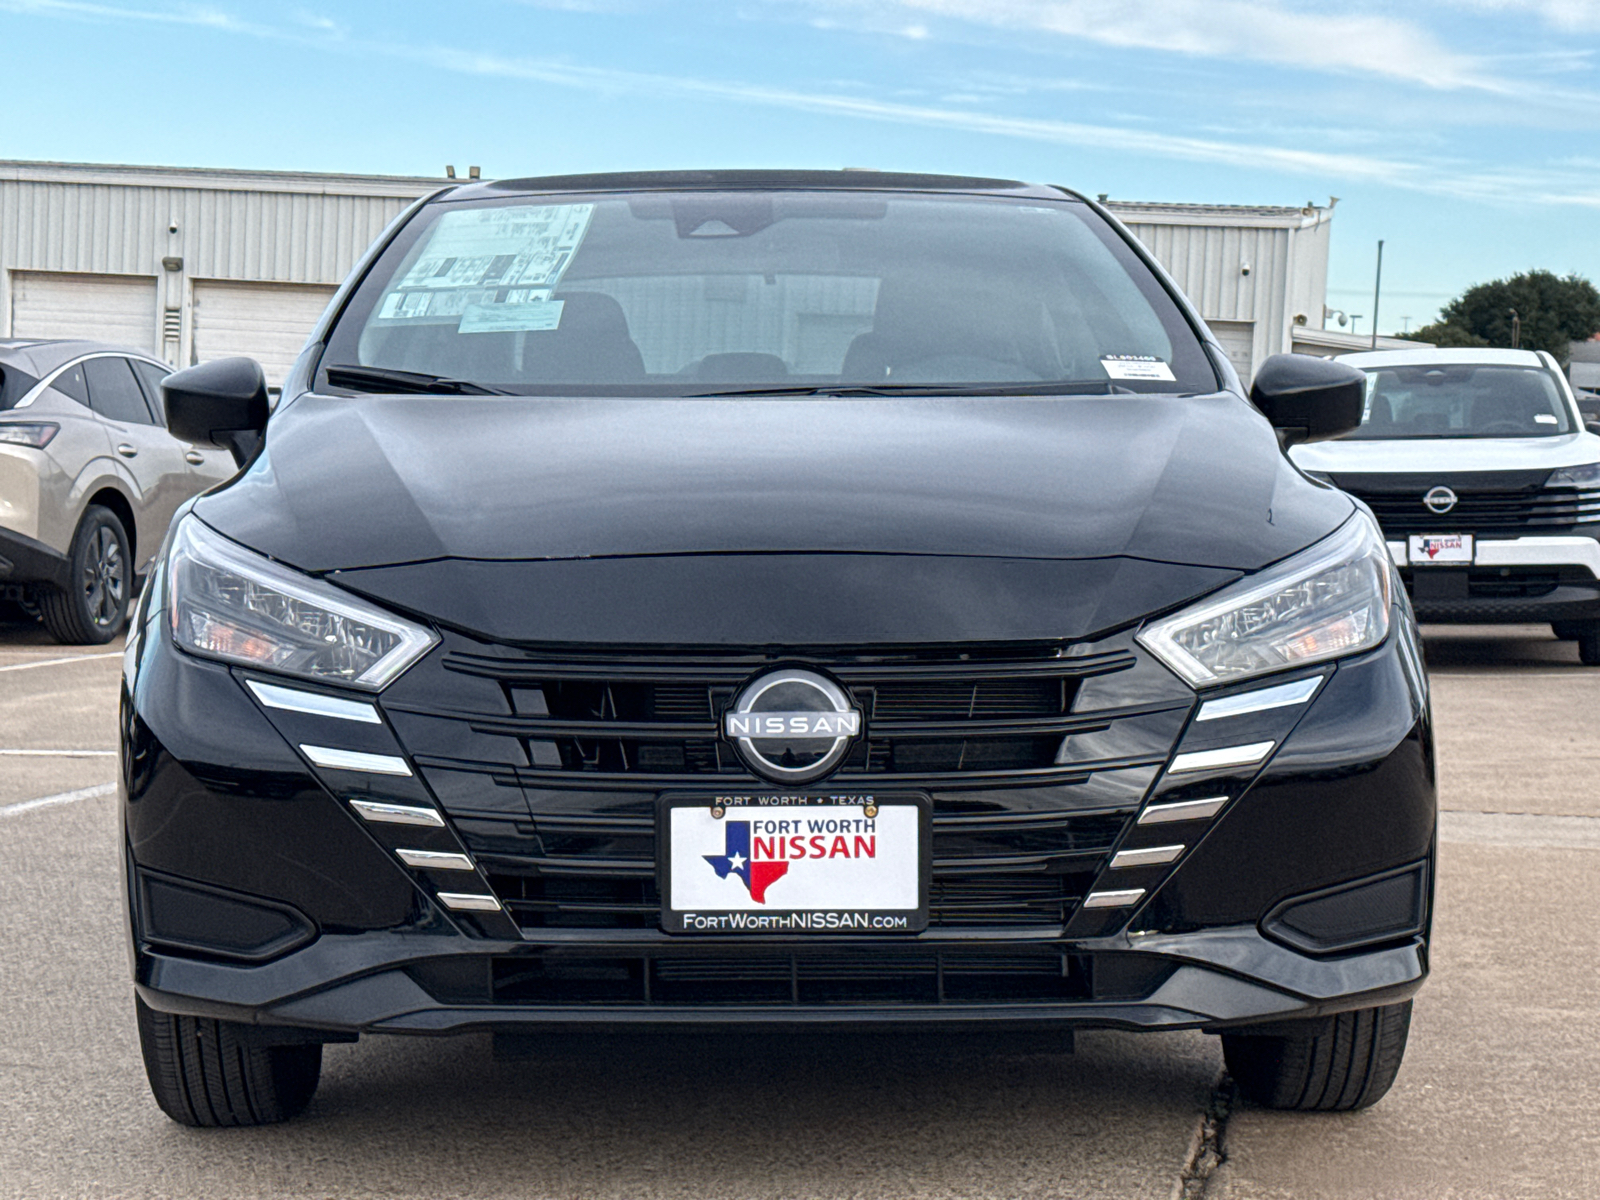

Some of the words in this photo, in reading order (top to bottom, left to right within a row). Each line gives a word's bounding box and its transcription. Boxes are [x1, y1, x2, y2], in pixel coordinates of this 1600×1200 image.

[1430, 541, 1462, 549] NISSAN
[730, 717, 857, 733] NISSAN
[715, 796, 751, 806] FORT
[758, 796, 808, 806] WORTH
[830, 796, 875, 806] TEXAS
[753, 820, 801, 834] FORT
[807, 819, 876, 834] WORTH
[753, 835, 876, 859] NISSAN
